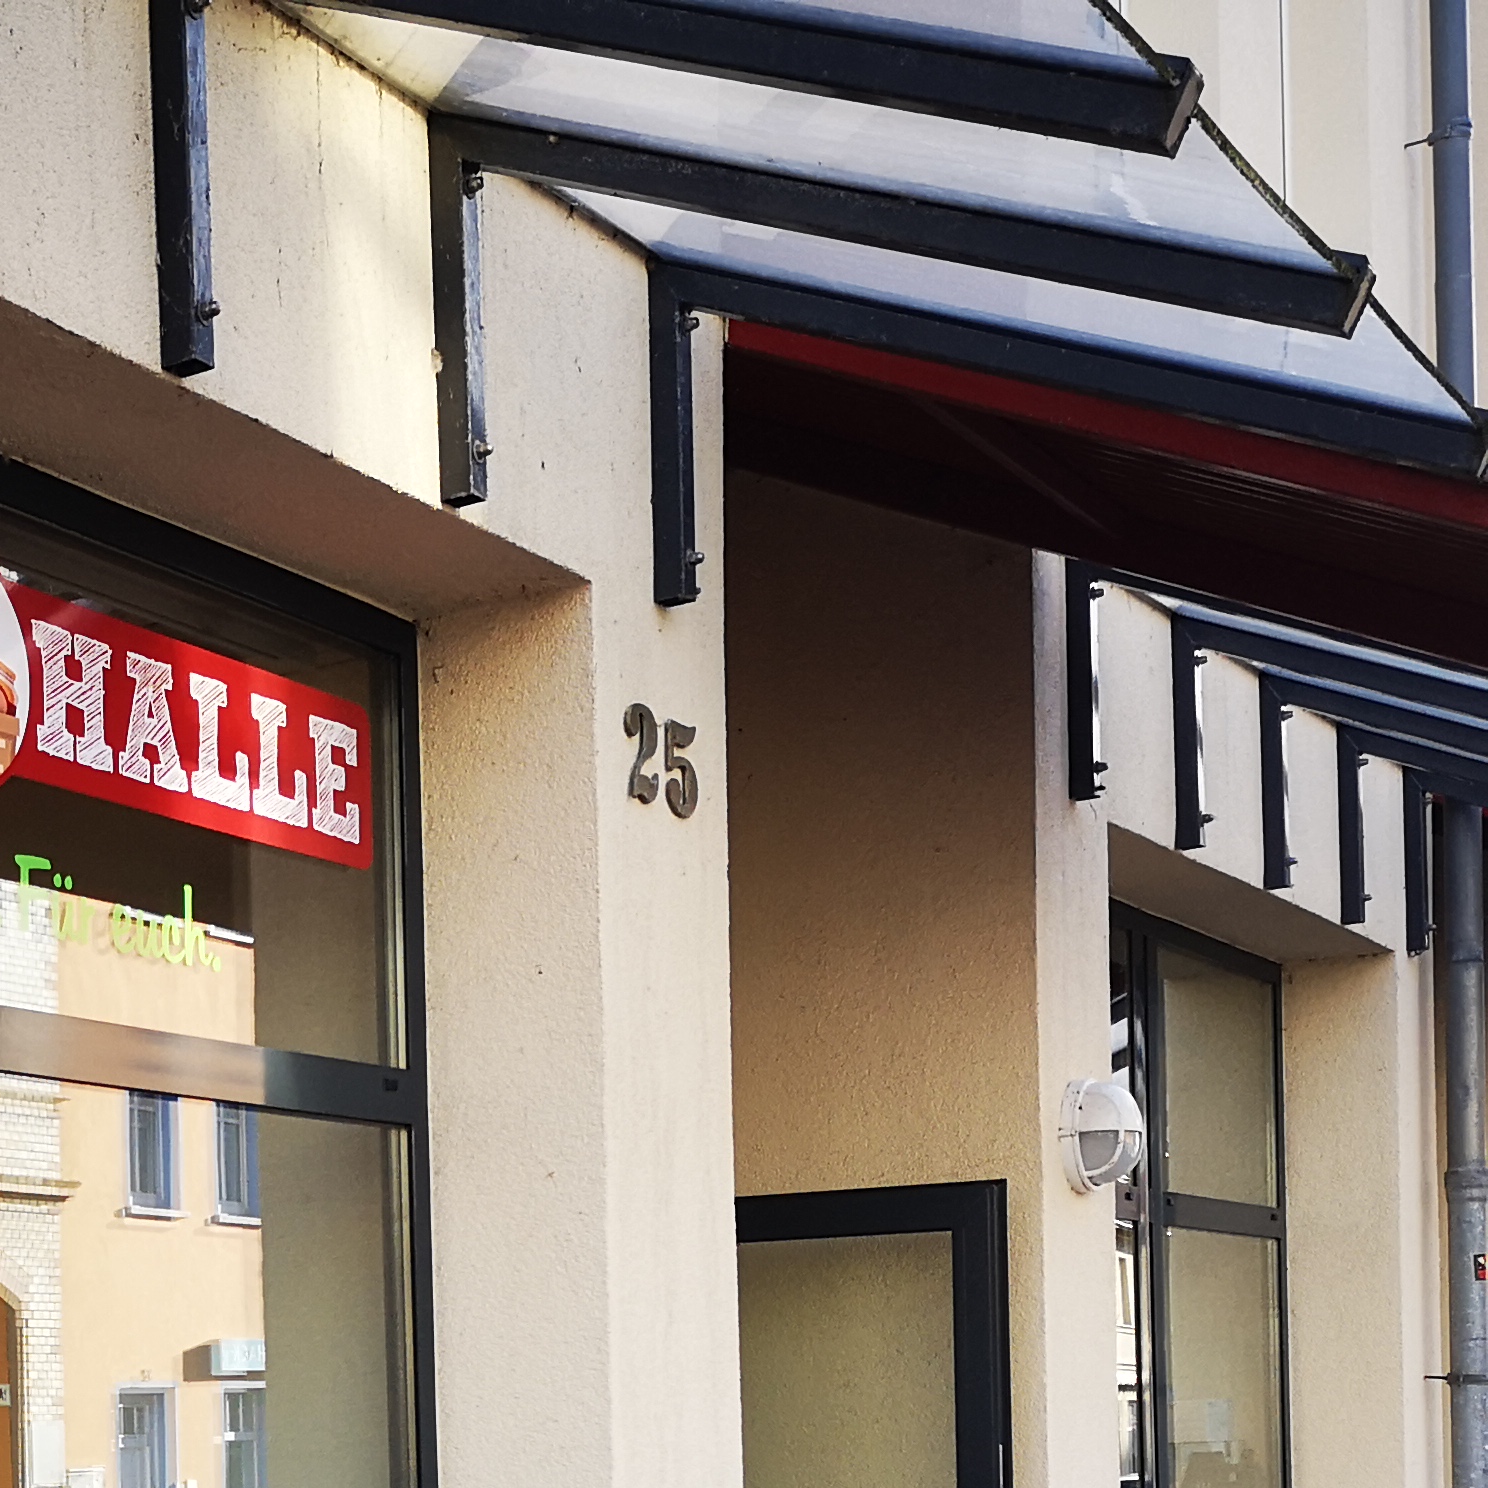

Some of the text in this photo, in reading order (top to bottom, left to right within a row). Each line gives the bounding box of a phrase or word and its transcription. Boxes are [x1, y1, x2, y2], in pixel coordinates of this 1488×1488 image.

[30, 618, 361, 845] HALLE
[622, 702, 699, 820] 25
[14, 854, 96, 944] Für
[112, 883, 222, 973] euch.
